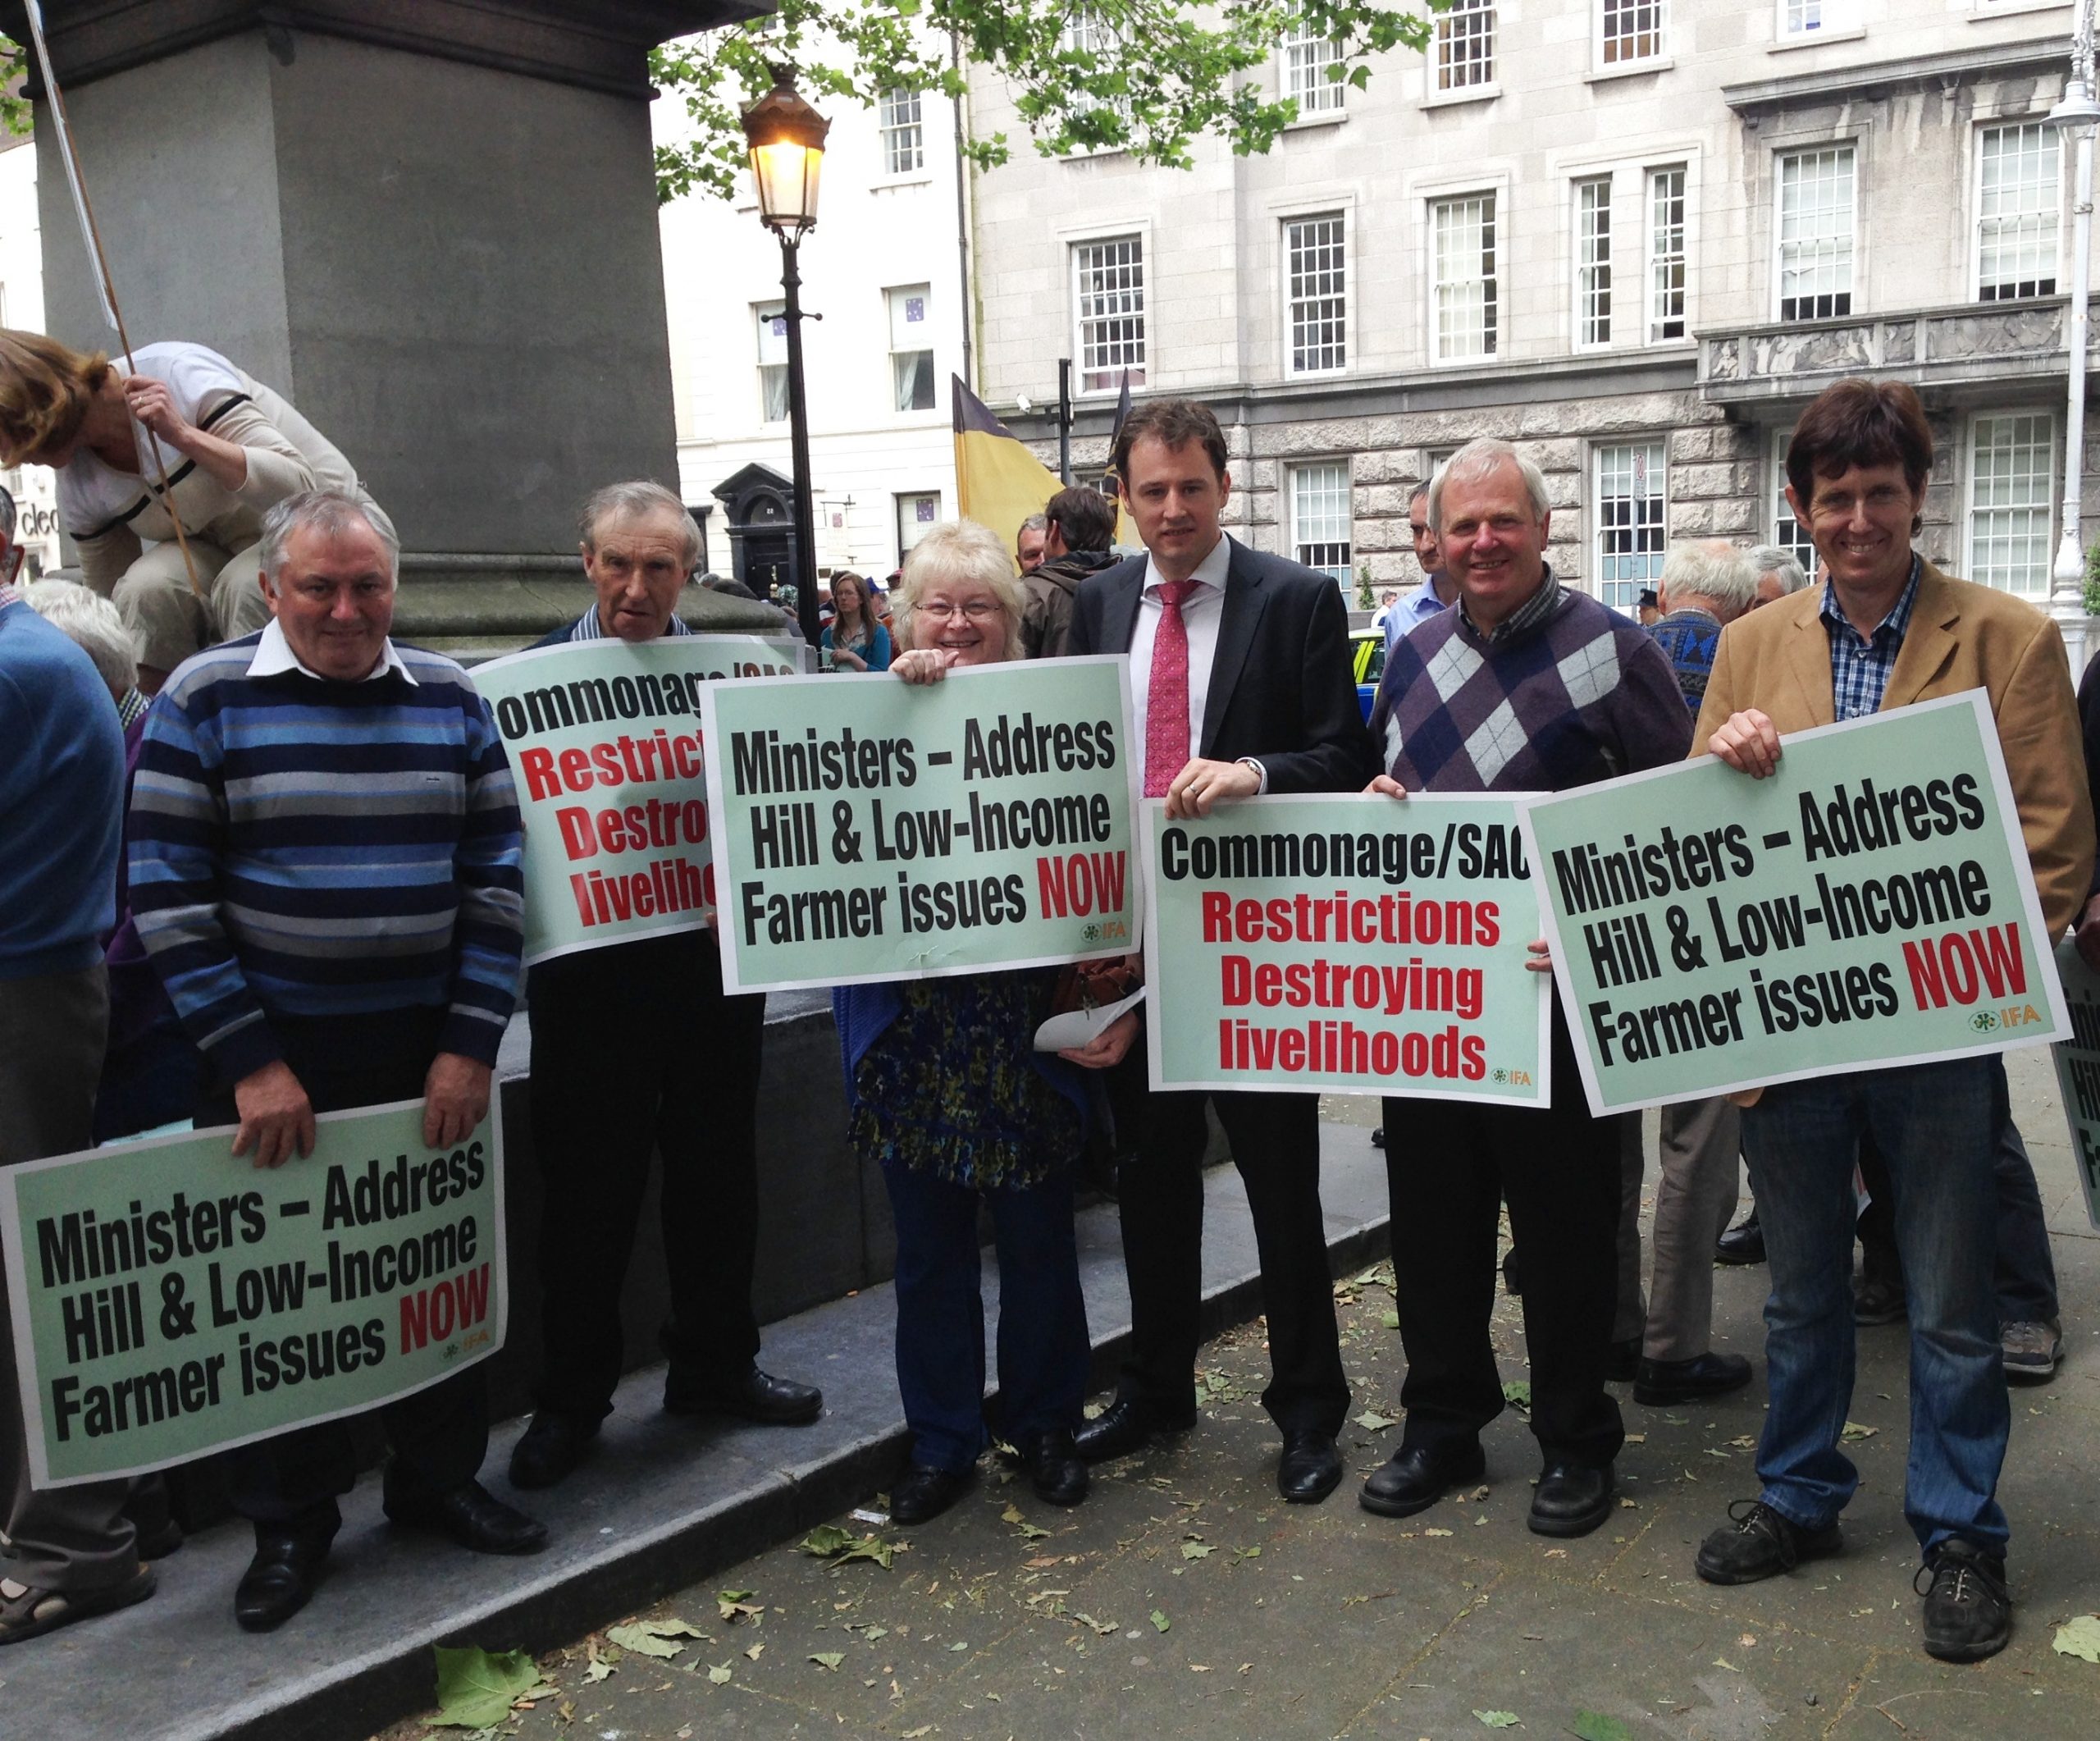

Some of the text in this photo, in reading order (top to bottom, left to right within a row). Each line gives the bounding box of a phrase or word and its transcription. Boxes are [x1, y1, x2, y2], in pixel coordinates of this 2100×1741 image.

[518, 729, 704, 802] Restric
[732, 727, 916, 795] Ministers
[963, 712, 1116, 780] Address
[555, 798, 707, 861] Destro
[750, 791, 1111, 869] Hill & Low-Income
[1551, 823, 1754, 916] Ministers
[1799, 773, 1984, 862] Address
[741, 850, 1125, 945] Farmer issues NOW
[1102, 921, 1126, 939] IFA
[1202, 890, 1500, 947] Restrictions
[1582, 859, 1991, 989] Hill & Low-Income
[1221, 955, 1484, 1020] Destroying
[1588, 922, 2028, 1067] Farmer issues NOW
[2001, 1004, 2042, 1028] IFA
[1219, 1019, 1486, 1081] livelihoods
[1510, 1070, 1532, 1086] IFA
[37, 1190, 266, 1288] Ministers
[322, 1141, 485, 1230] Address
[62, 1215, 477, 1364] Hill & Low-Income
[52, 1263, 490, 1442] Farmer issues NOW
